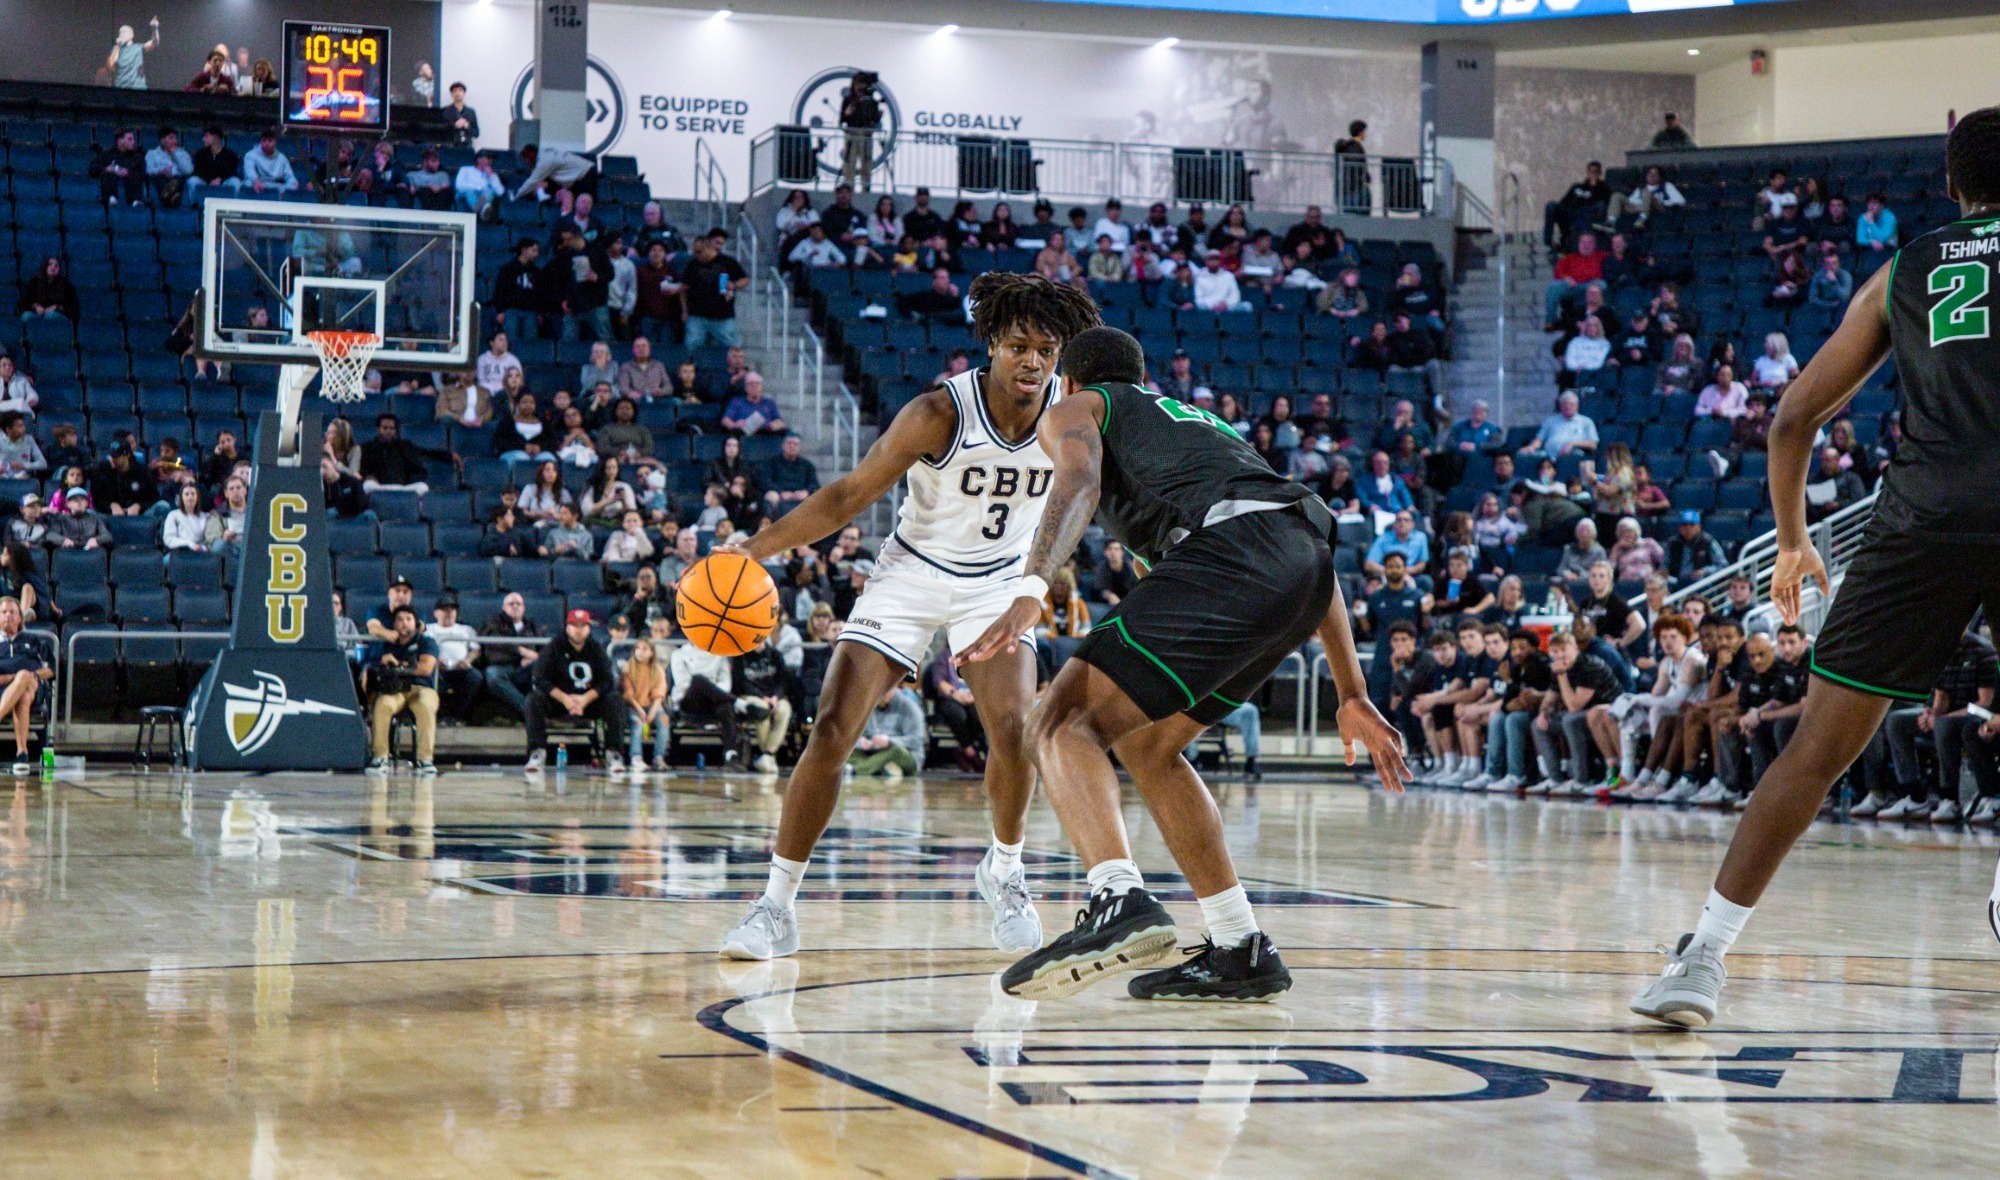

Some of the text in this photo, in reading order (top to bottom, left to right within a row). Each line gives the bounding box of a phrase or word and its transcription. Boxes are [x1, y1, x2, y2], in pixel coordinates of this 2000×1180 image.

[311, 25, 363, 34] DAKTRONICS
[305, 34, 377, 65] 10:49
[305, 66, 365, 119] 25
[640, 94, 749, 116] EQUIPPED
[639, 114, 744, 135] TO SERVE
[914, 110, 1022, 131] GLOBALLY
[1940, 237, 2000, 260] TSHIMA
[1927, 260, 1990, 348] 2
[959, 465, 1054, 500] CBU
[981, 503, 1010, 540] 3
[265, 493, 308, 643] CBU
[847, 617, 883, 631] LANCERS
